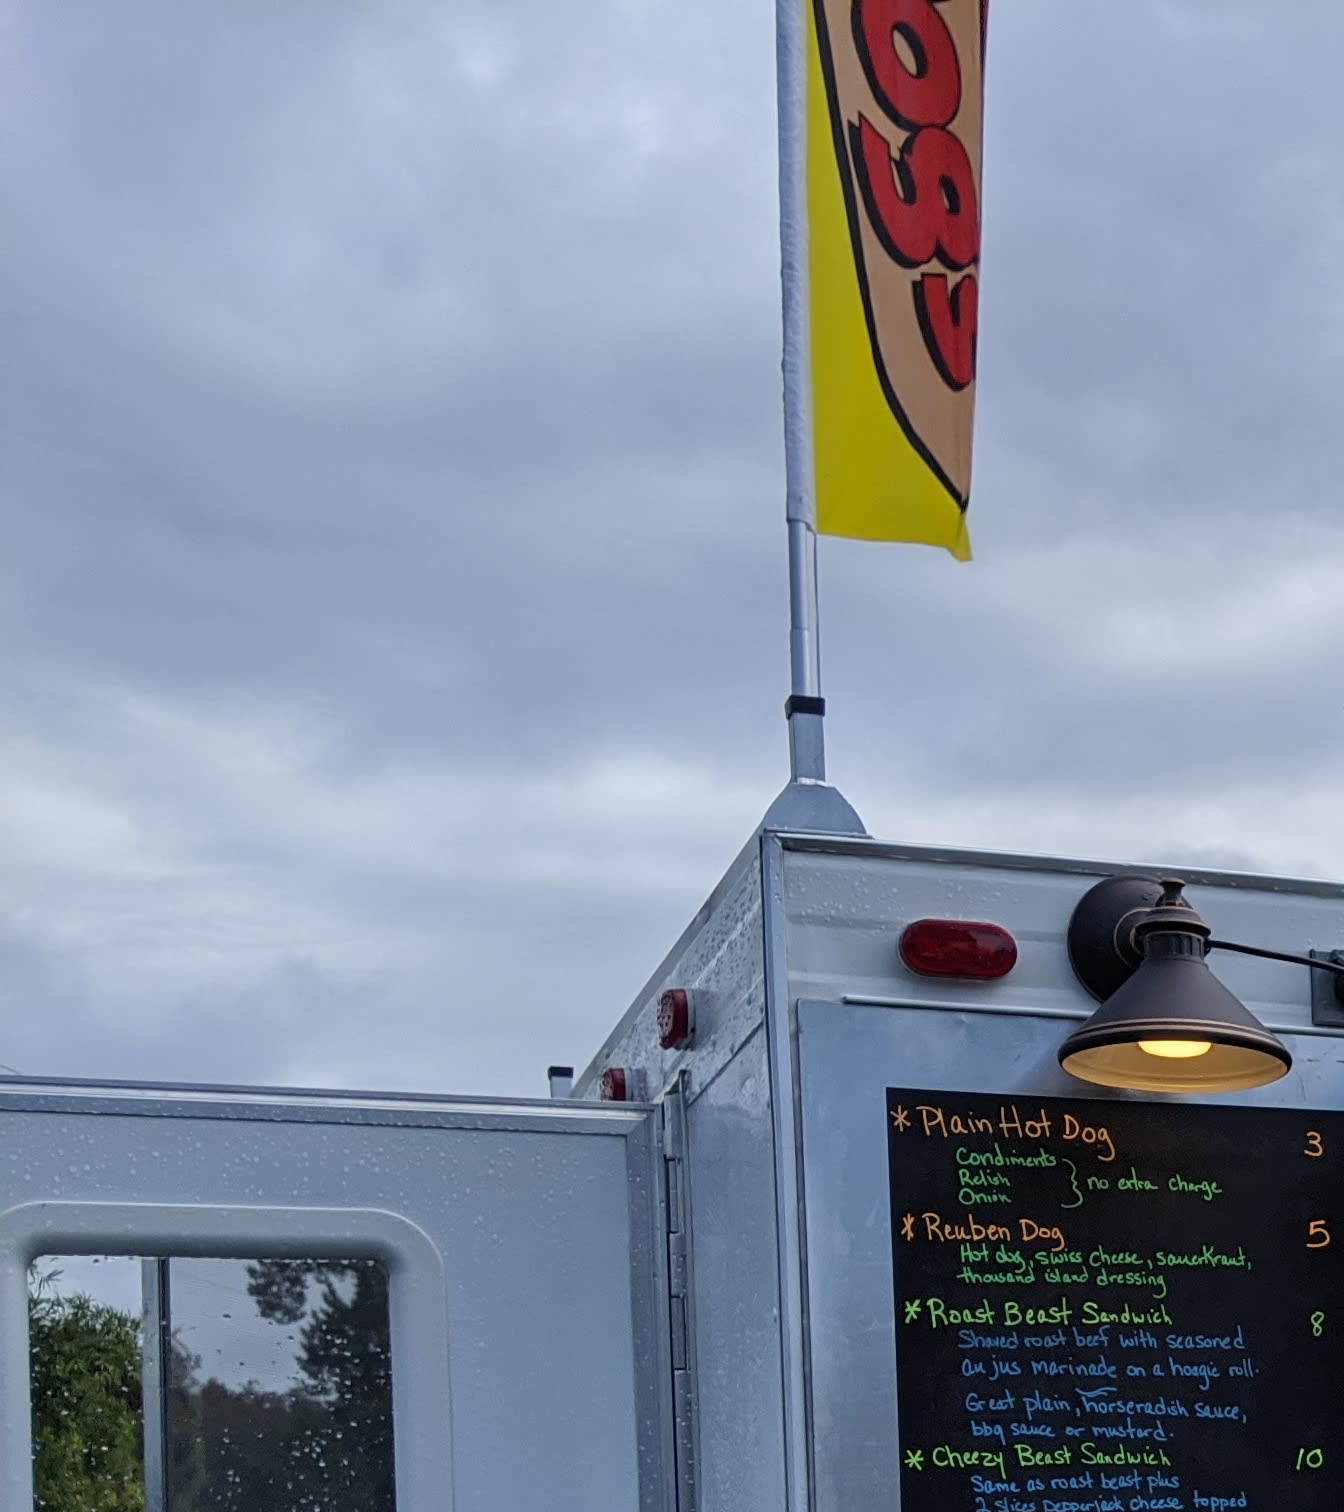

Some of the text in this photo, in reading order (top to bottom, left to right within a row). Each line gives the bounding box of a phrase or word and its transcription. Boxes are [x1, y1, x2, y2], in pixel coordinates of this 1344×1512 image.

[916, 1106, 1115, 1161] Plain Hot Dog
[1303, 1131, 1325, 1157] 3
[956, 1143, 1056, 1167] Condiments
[959, 1169, 1011, 1187] Relish
[1087, 1166, 1222, 1201] no extra charge
[958, 1188, 1012, 1205] Onion
[922, 1213, 1065, 1252] Reuben Dog
[1306, 1220, 1331, 1248] 5
[960, 1243, 989, 1264] Hot
[1035, 1247, 1083, 1265] swiss
[956, 1265, 1167, 1299] thousand island dressing
[926, 1297, 1173, 1329] Roast Beast Sandwich
[1310, 1310, 1325, 1337] 8
[958, 1324, 1246, 1349] Shaved roast beef with seasoned
[961, 1358, 986, 1377] au
[988, 1354, 1022, 1381] jus
[1031, 1355, 1118, 1378] marinade
[1126, 1364, 1146, 1378] on
[1152, 1364, 1165, 1377] a
[1168, 1356, 1220, 1391] hoagie
[1083, 1396, 1190, 1418] horseradish
[970, 1420, 1007, 1446] bbq
[1010, 1421, 1056, 1438] sauce
[1065, 1425, 1085, 1437] or
[931, 1442, 1172, 1480] Cheezy Beast Sandwich
[1296, 1447, 1324, 1471] 10
[970, 1469, 1180, 1494] Same as roast beast plus
[1129, 1492, 1184, 1511] cheese
[1193, 1491, 1248, 1512] topped
